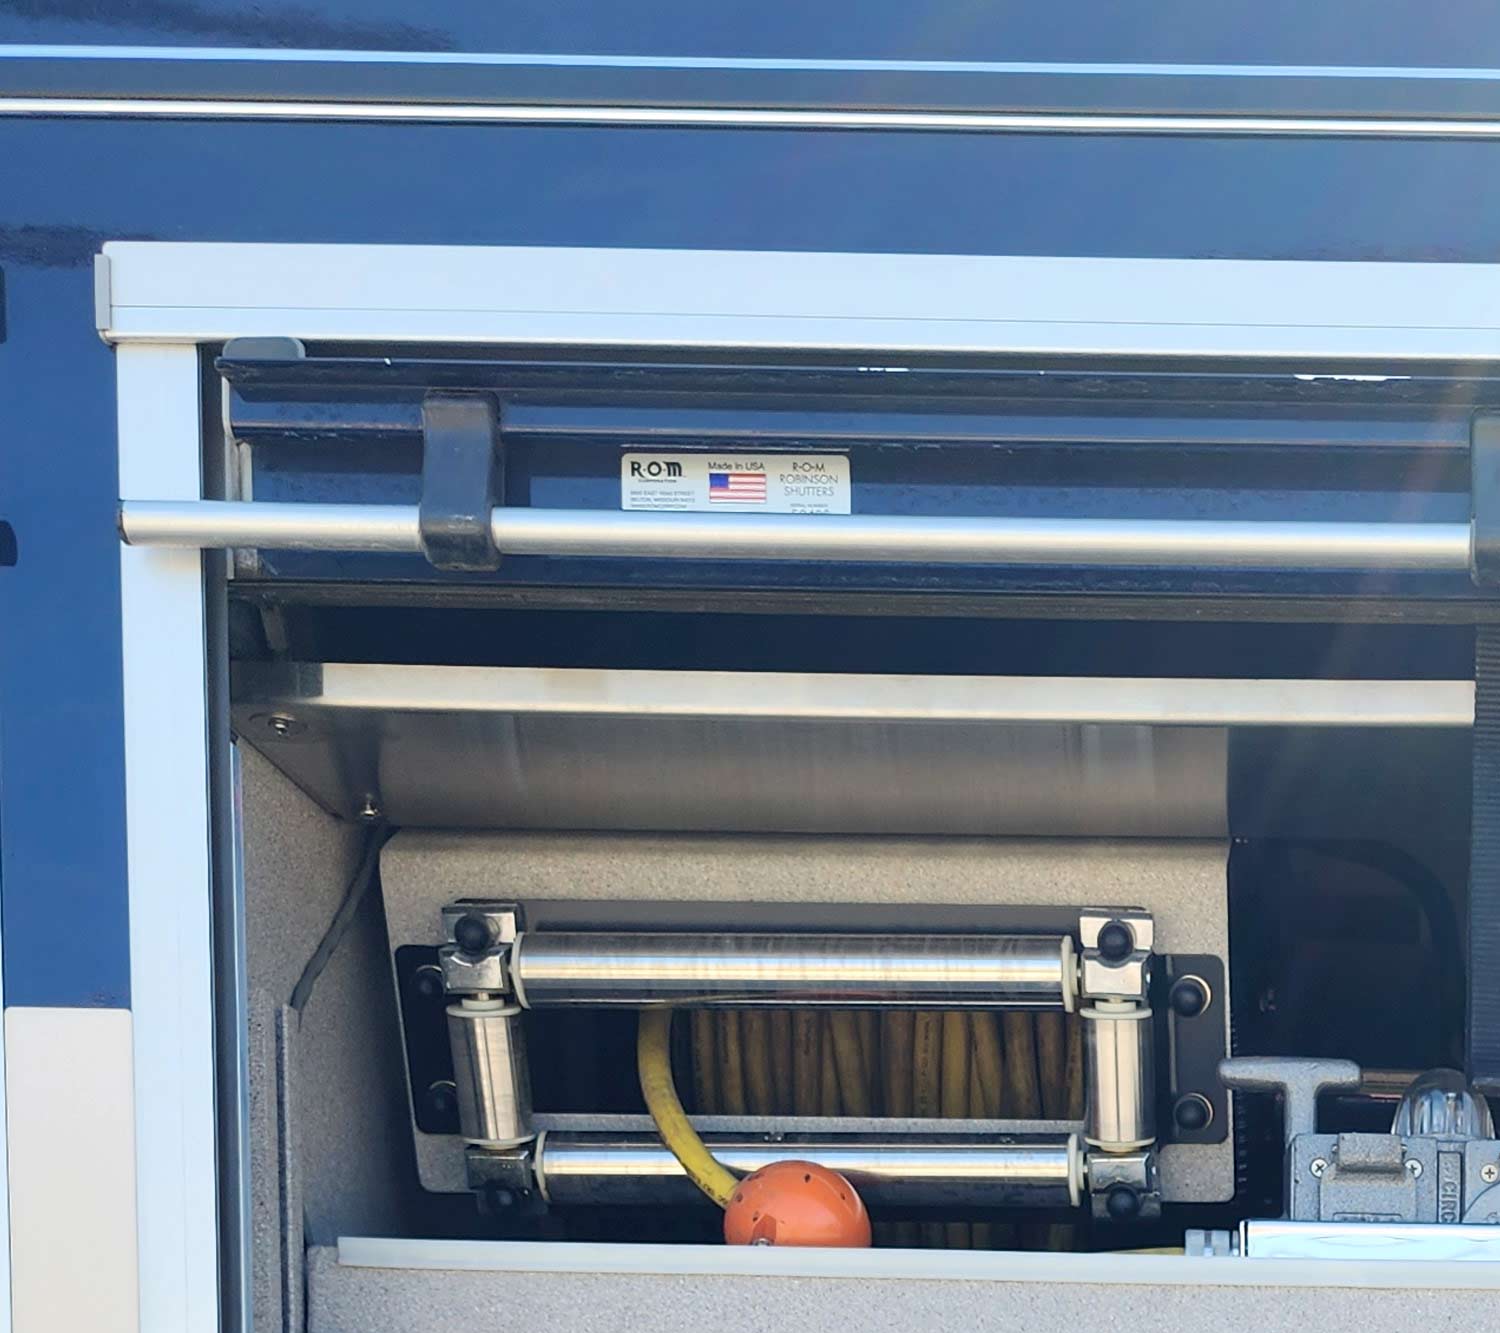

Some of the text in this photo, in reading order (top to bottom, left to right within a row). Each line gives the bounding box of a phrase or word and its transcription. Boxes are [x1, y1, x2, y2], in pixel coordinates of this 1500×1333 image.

[708, 462, 733, 470] Made
[745, 462, 766, 471] USA
[779, 473, 839, 485] ROBINSON
[783, 486, 835, 497] SHUTTERS
